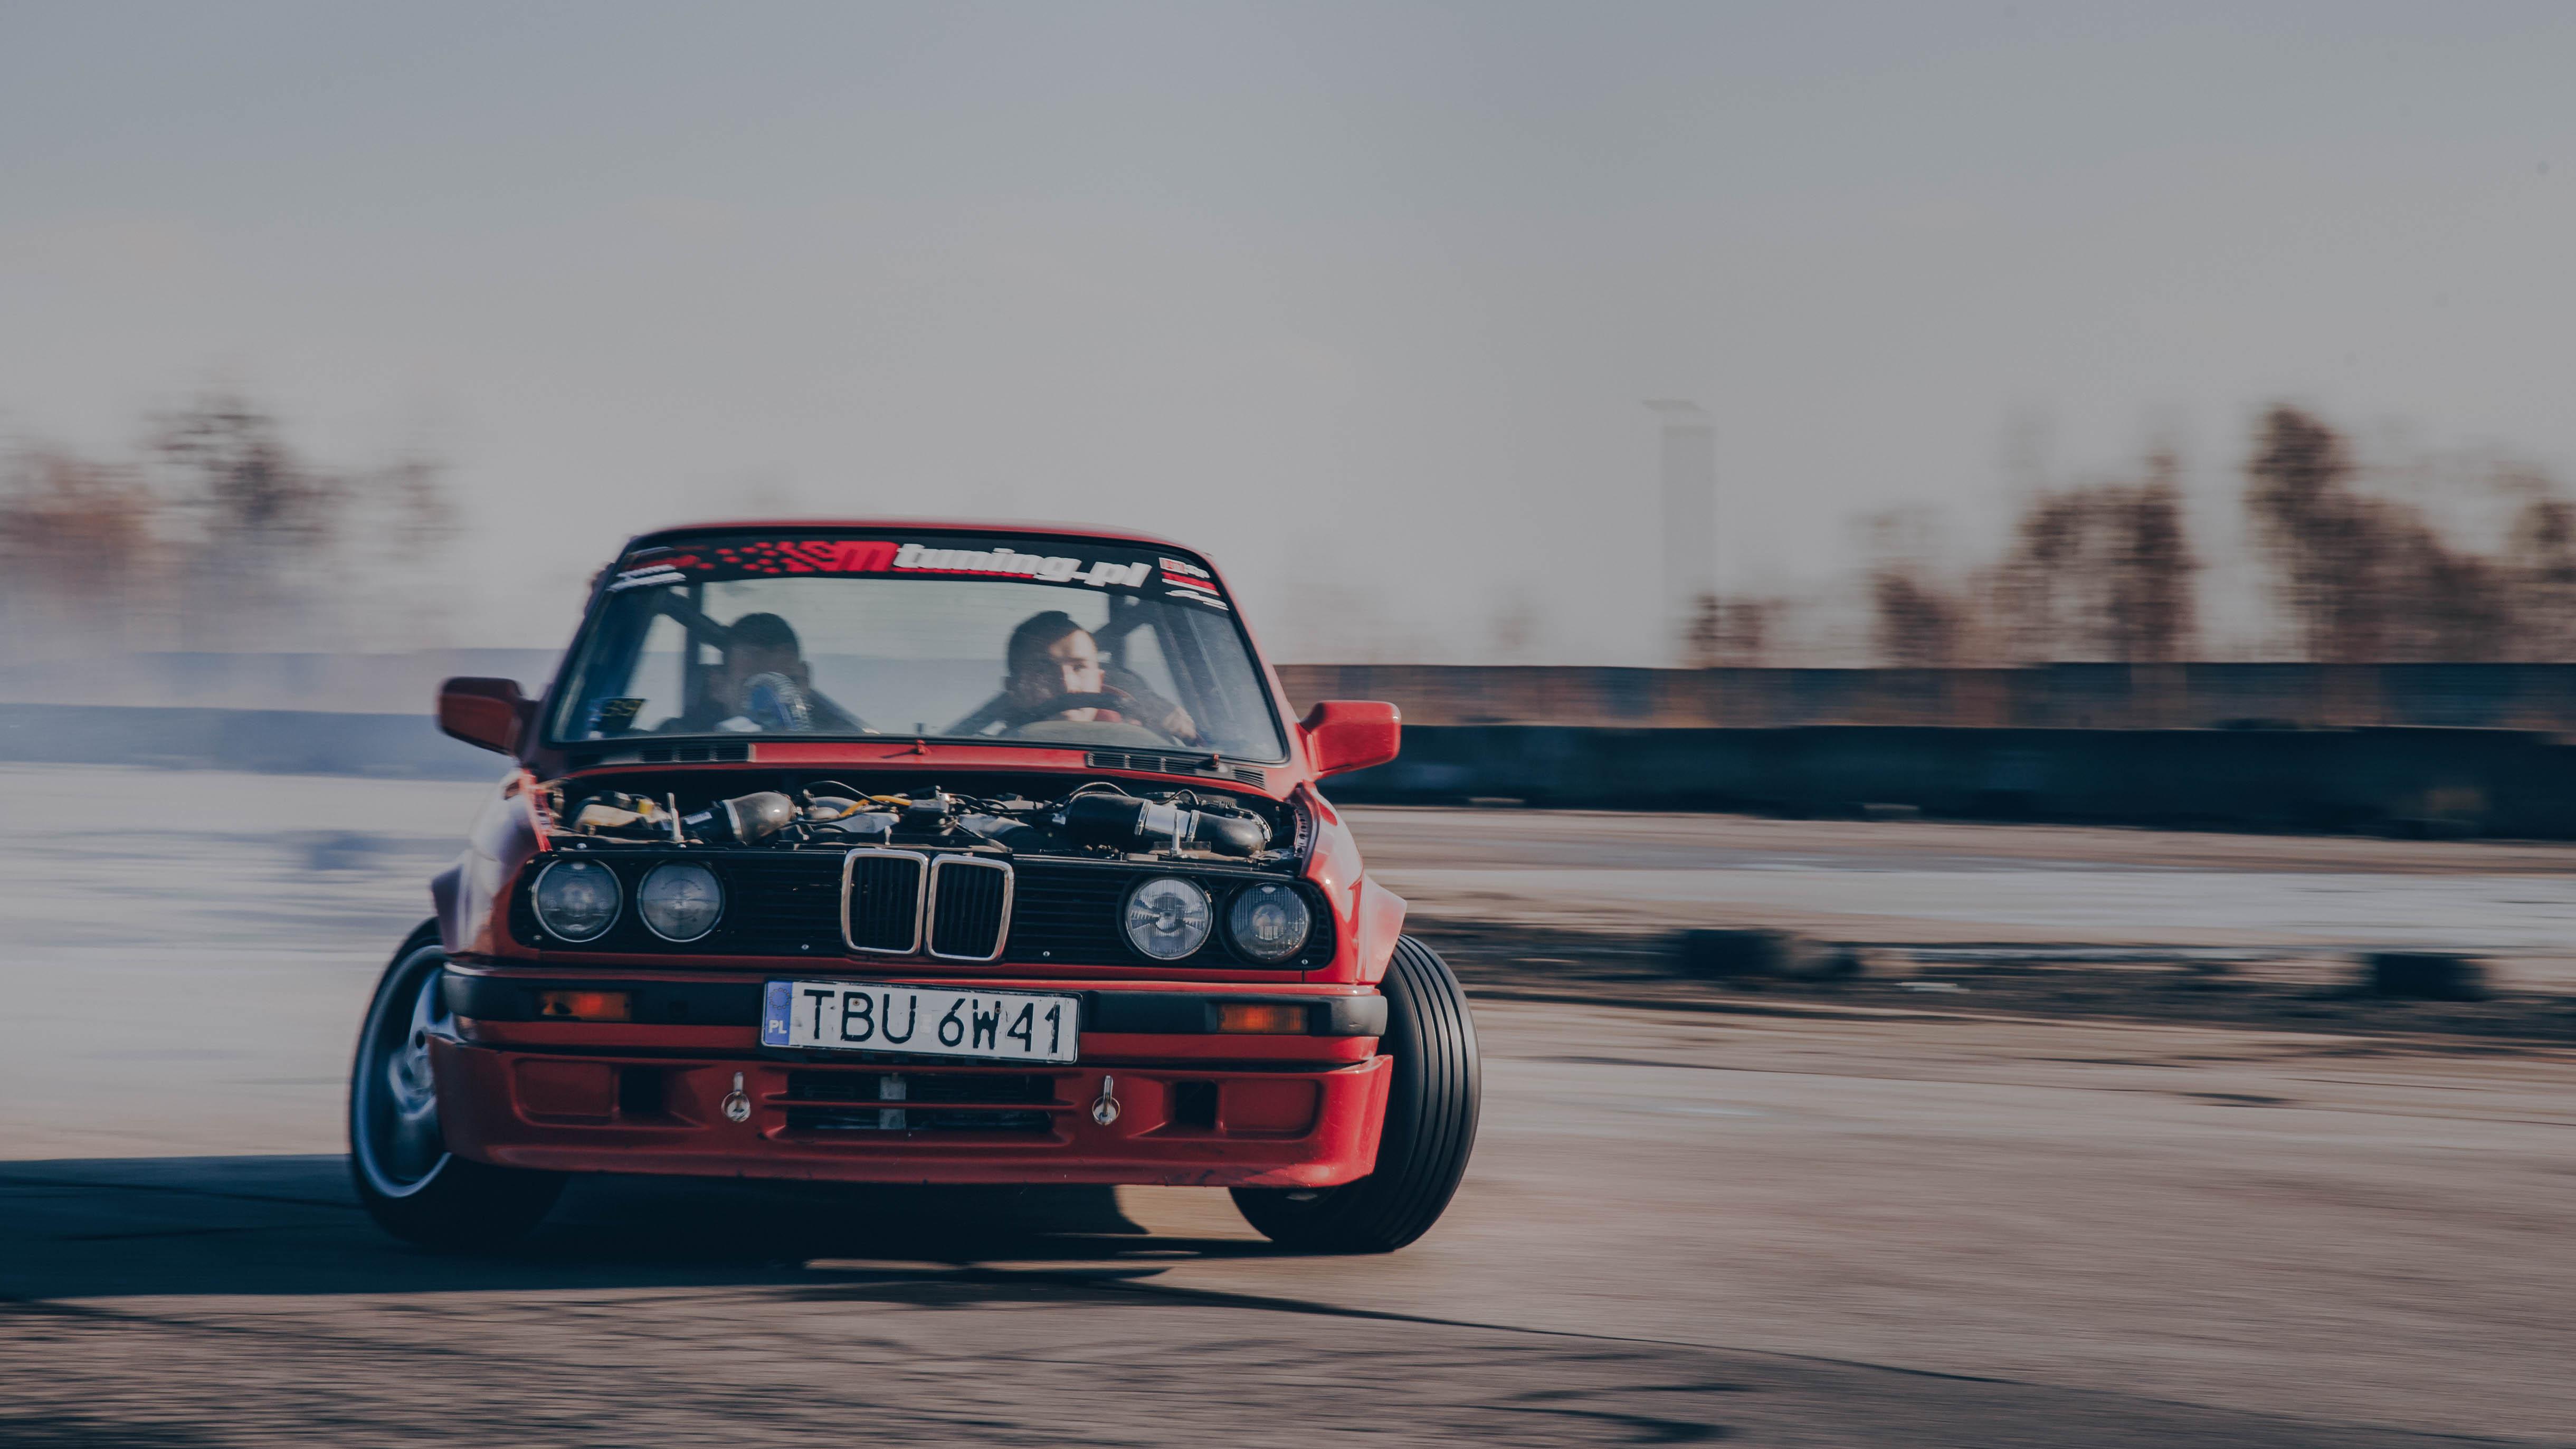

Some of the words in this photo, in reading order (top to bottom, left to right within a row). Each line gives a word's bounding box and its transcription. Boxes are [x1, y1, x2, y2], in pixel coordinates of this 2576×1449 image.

[768, 1019, 787, 1035] PL
[803, 989, 917, 1044] TBU
[938, 997, 1061, 1054] 6W41
